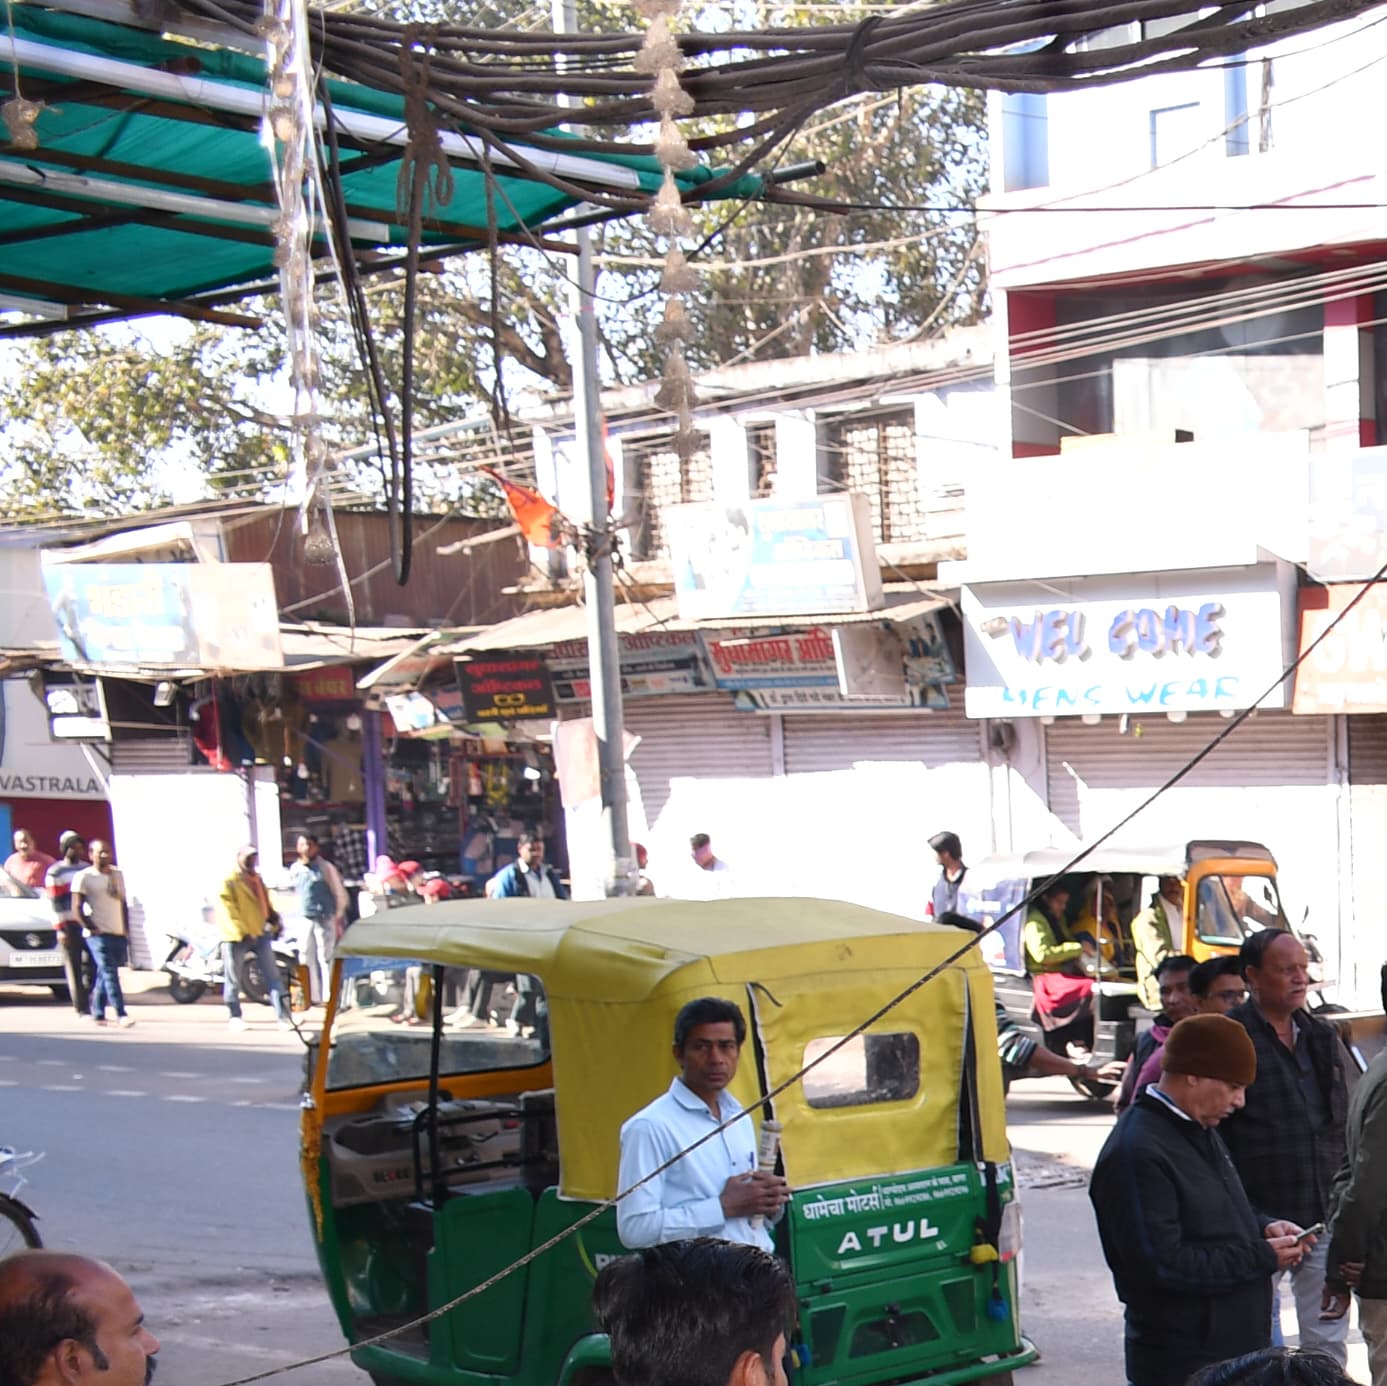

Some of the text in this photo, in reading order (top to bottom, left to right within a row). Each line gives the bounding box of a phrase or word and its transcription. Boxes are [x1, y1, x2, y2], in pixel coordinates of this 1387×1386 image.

[1009, 602, 1226, 666] WEL COME
[1126, 675, 1239, 706] WEAR
[803, 1194, 845, 1221] धामेचा
[847, 1184, 881, 1214] मोटर्स
[837, 1218, 939, 1254] ATUL
